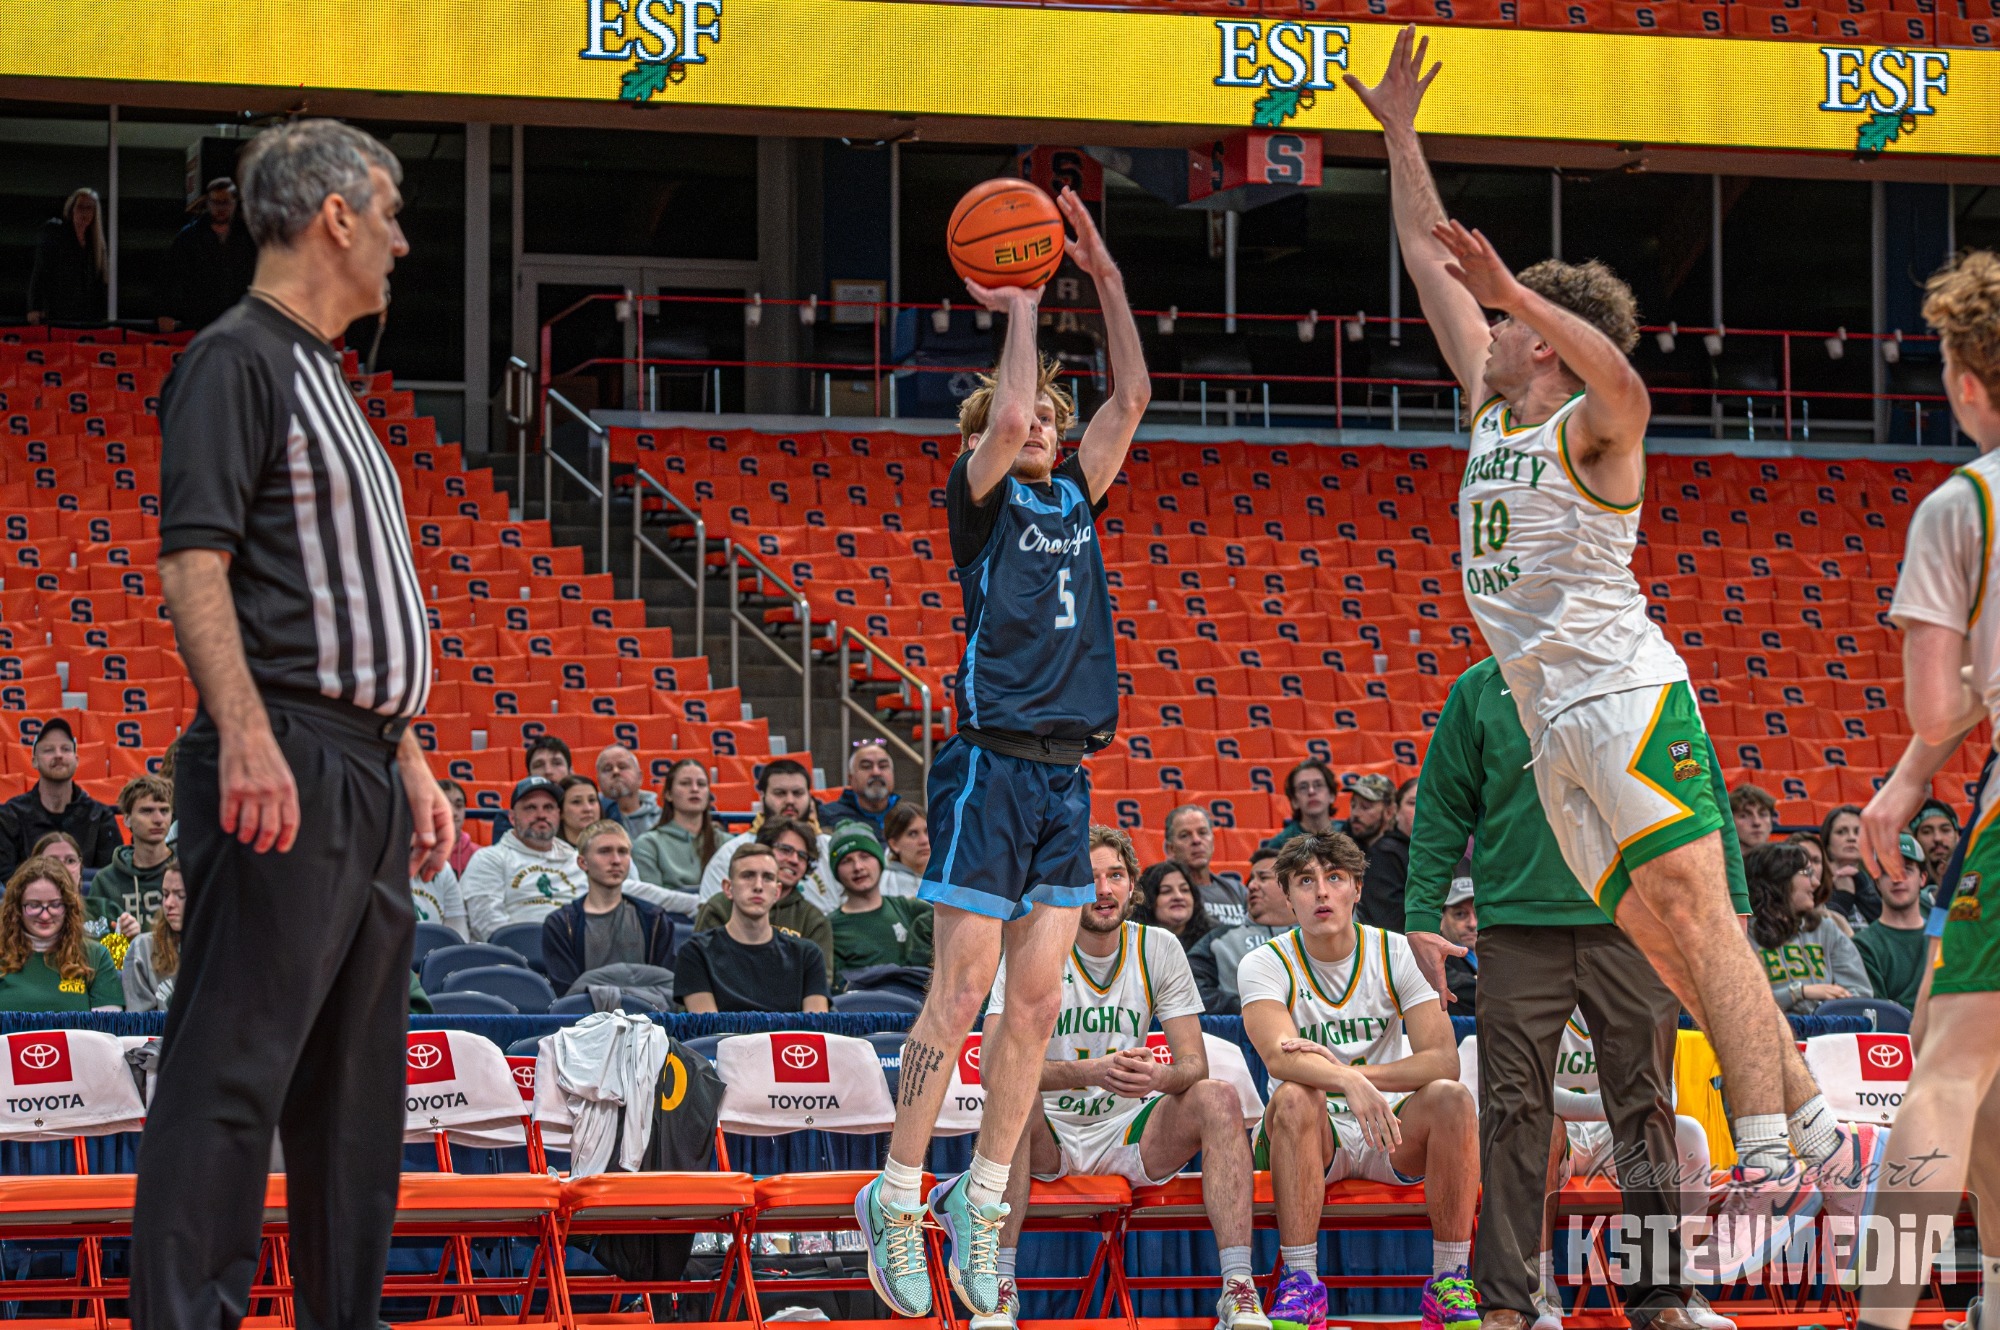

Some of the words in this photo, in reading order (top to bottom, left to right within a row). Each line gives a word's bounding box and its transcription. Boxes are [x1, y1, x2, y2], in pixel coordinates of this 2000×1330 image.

[1434, 0, 1454, 19] S
[1636, 8, 1656, 28] S
[1703, 10, 1721, 31] S
[580, 0, 722, 63] ESF
[1771, 15, 1789, 33] S
[1907, 19, 1925, 39] S
[1972, 25, 1991, 44] S
[1216, 20, 1350, 89] ESF
[1819, 46, 1950, 116] ESF
[1266, 133, 1305, 184] S
[994, 235, 1053, 266] ELITE
[117, 373, 135, 391] S
[69, 393, 88, 413] S
[367, 398, 387, 418] S
[9, 415, 29, 435] S
[389, 425, 408, 446] S
[27, 441, 47, 462] S
[106, 442, 126, 463] S
[851, 438, 869, 456] S
[115, 469, 135, 489] S
[885, 462, 904, 485] S
[769, 482, 790, 503] S
[848, 485, 867, 505] S
[139, 495, 160, 517] S
[1306, 496, 1325, 516] S
[6, 515, 28, 541] S
[89, 519, 111, 542] S
[420, 524, 441, 547] S
[1264, 521, 1284, 541] S
[1470, 498, 1511, 558] 10
[759, 535, 779, 555] S
[836, 533, 856, 558] S
[912, 539, 933, 560] S
[1149, 543, 1169, 565] S
[1225, 545, 1246, 566] S
[1677, 554, 1696, 574] S
[1750, 557, 1770, 577] S
[122, 573, 145, 596] S
[1467, 556, 1521, 596] OAKS
[1055, 566, 1077, 630] 5
[1341, 599, 1361, 619] S
[70, 599, 93, 623] S
[506, 607, 528, 630] S
[867, 615, 889, 637] S
[1116, 619, 1136, 639] S
[1358, 625, 1381, 650] S
[904, 644, 926, 667] S
[1157, 648, 1179, 670] S
[1416, 652, 1438, 675] S
[103, 655, 127, 680] S
[563, 664, 586, 689] S
[653, 667, 677, 691] S
[2, 687, 26, 711] S
[123, 688, 147, 712] S
[494, 691, 518, 715] S
[684, 700, 707, 723] S
[116, 721, 142, 748] S
[413, 723, 437, 751] S
[614, 723, 639, 750] S
[711, 730, 736, 755] S
[1393, 741, 1417, 766] S
[1738, 745, 1763, 770] S
[1250, 768, 1274, 793] S
[1116, 800, 1141, 829] S
[1210, 800, 1235, 828] S
[1556, 1051, 1598, 1075] IGH
[6, 1093, 85, 1113] TOYOTA
[405, 1092, 469, 1112] OYOTA
[767, 1094, 840, 1111] TOYOTA
[1058, 1093, 1115, 1116] OAKS
[1855, 1092, 1906, 1106] TOYO
